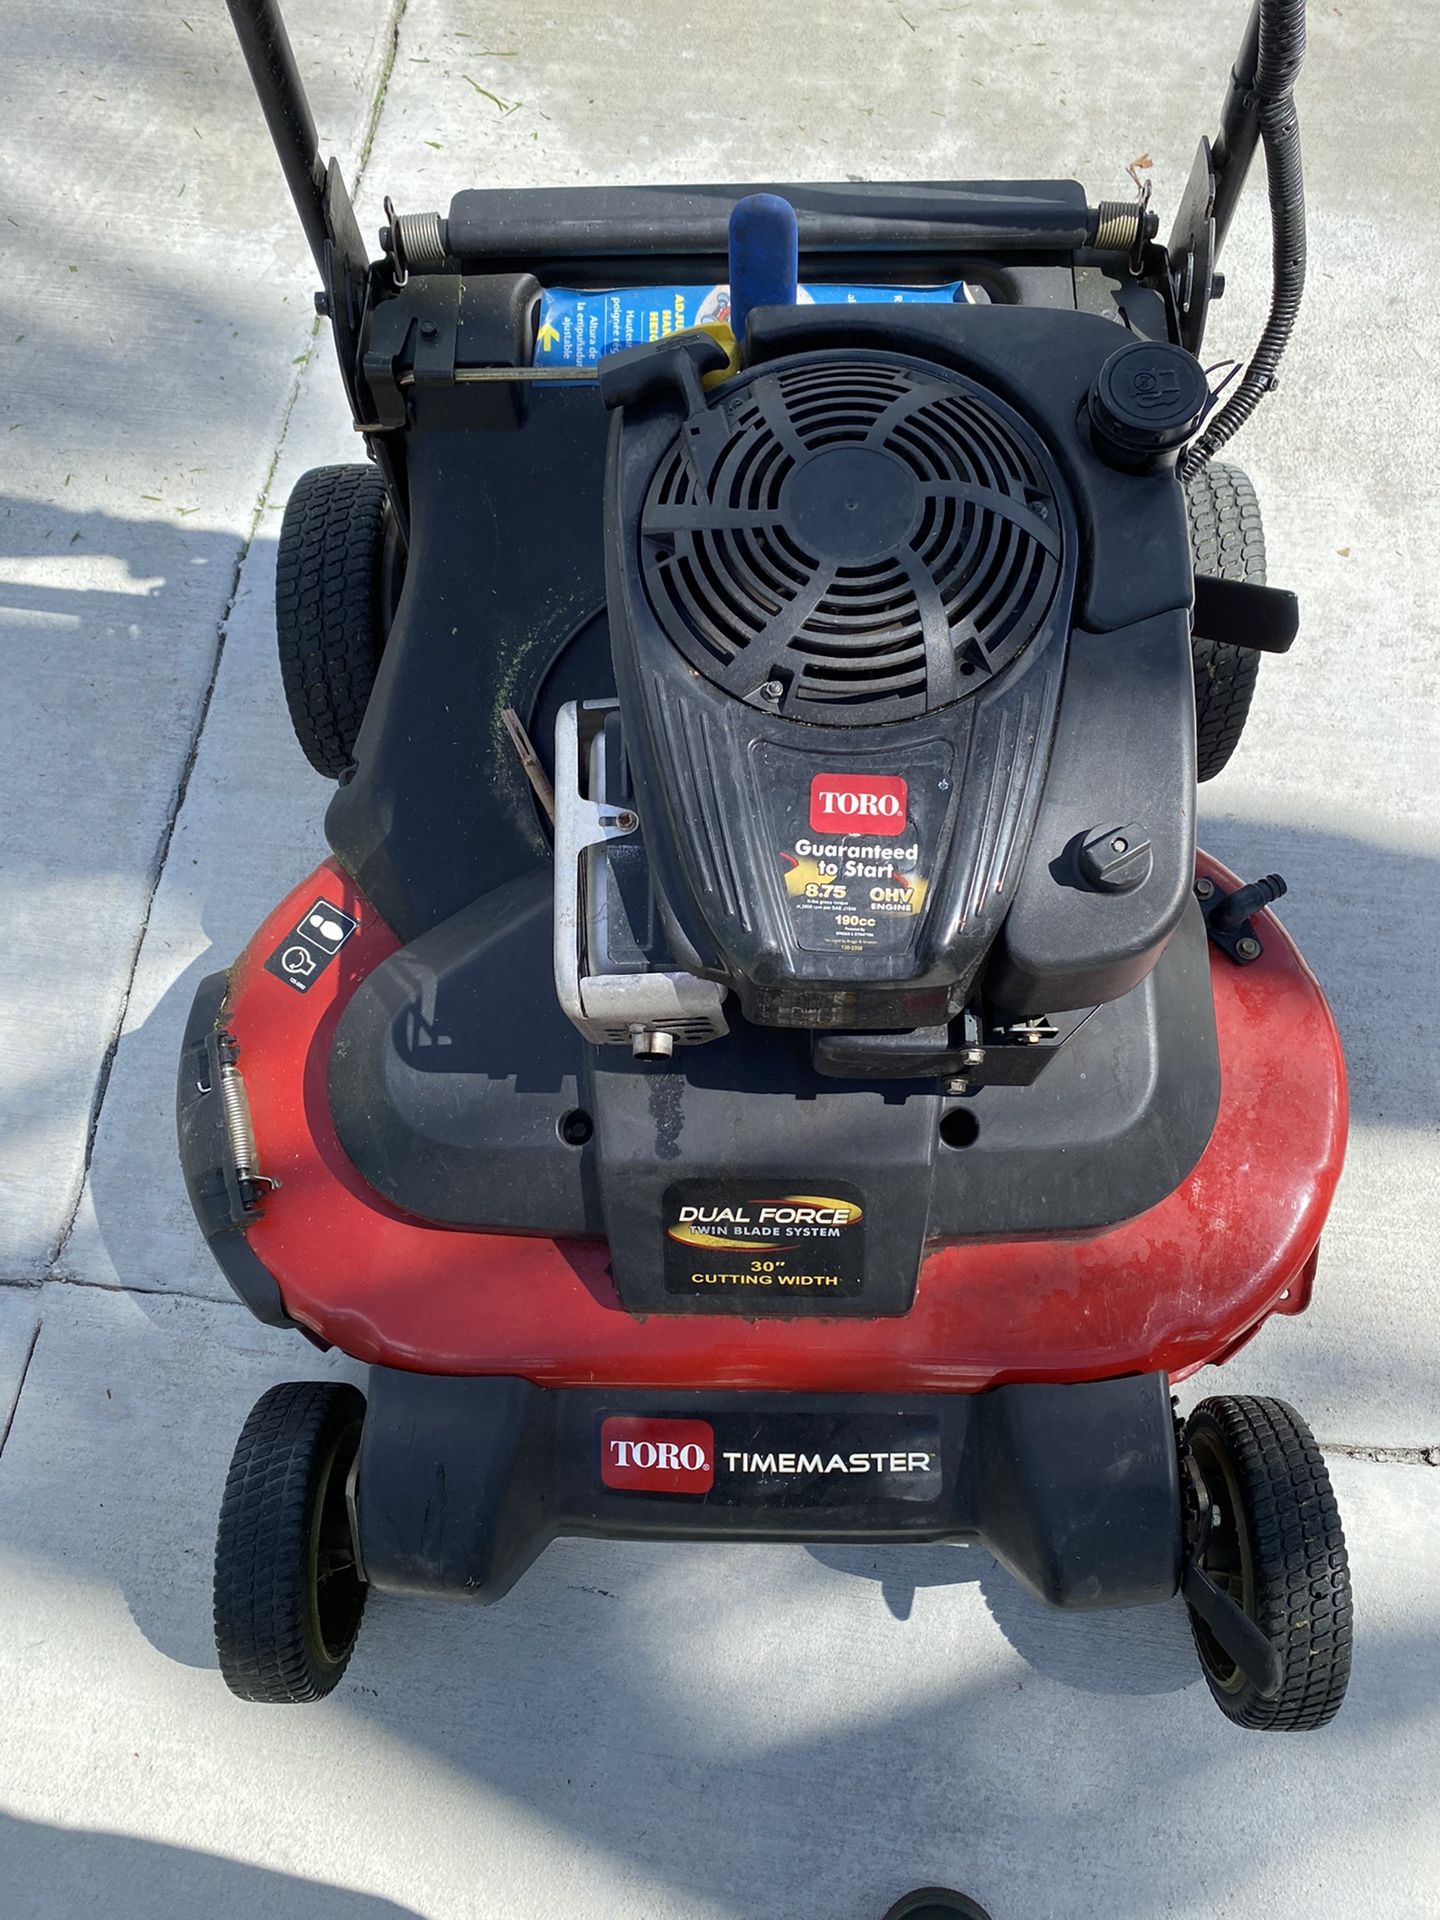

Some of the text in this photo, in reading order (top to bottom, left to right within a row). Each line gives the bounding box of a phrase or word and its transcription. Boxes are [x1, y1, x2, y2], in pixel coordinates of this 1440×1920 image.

[577, 302, 586, 311] la
[675, 293, 685, 332] ADJU
[610, 297, 622, 336] poignée
[562, 316, 573, 359] ajustable
[588, 315, 599, 359] Altura de
[625, 310, 635, 348] Hauteur
[819, 792, 900, 816] TORO
[795, 839, 918, 860] Guaranteed
[818, 860, 894, 878] to Start
[805, 883, 847, 899] 8.75
[869, 887, 914, 904] OHV
[871, 903, 912, 912] ENGINE
[835, 914, 876, 927] 190cc
[679, 1206, 852, 1224] DUAL FORCE
[689, 1225, 841, 1237] TWIN BLADE SYSTEM
[691, 1274, 838, 1286] CUTTING WIDTH
[610, 1440, 931, 1474] TORO TIMEMASTER
